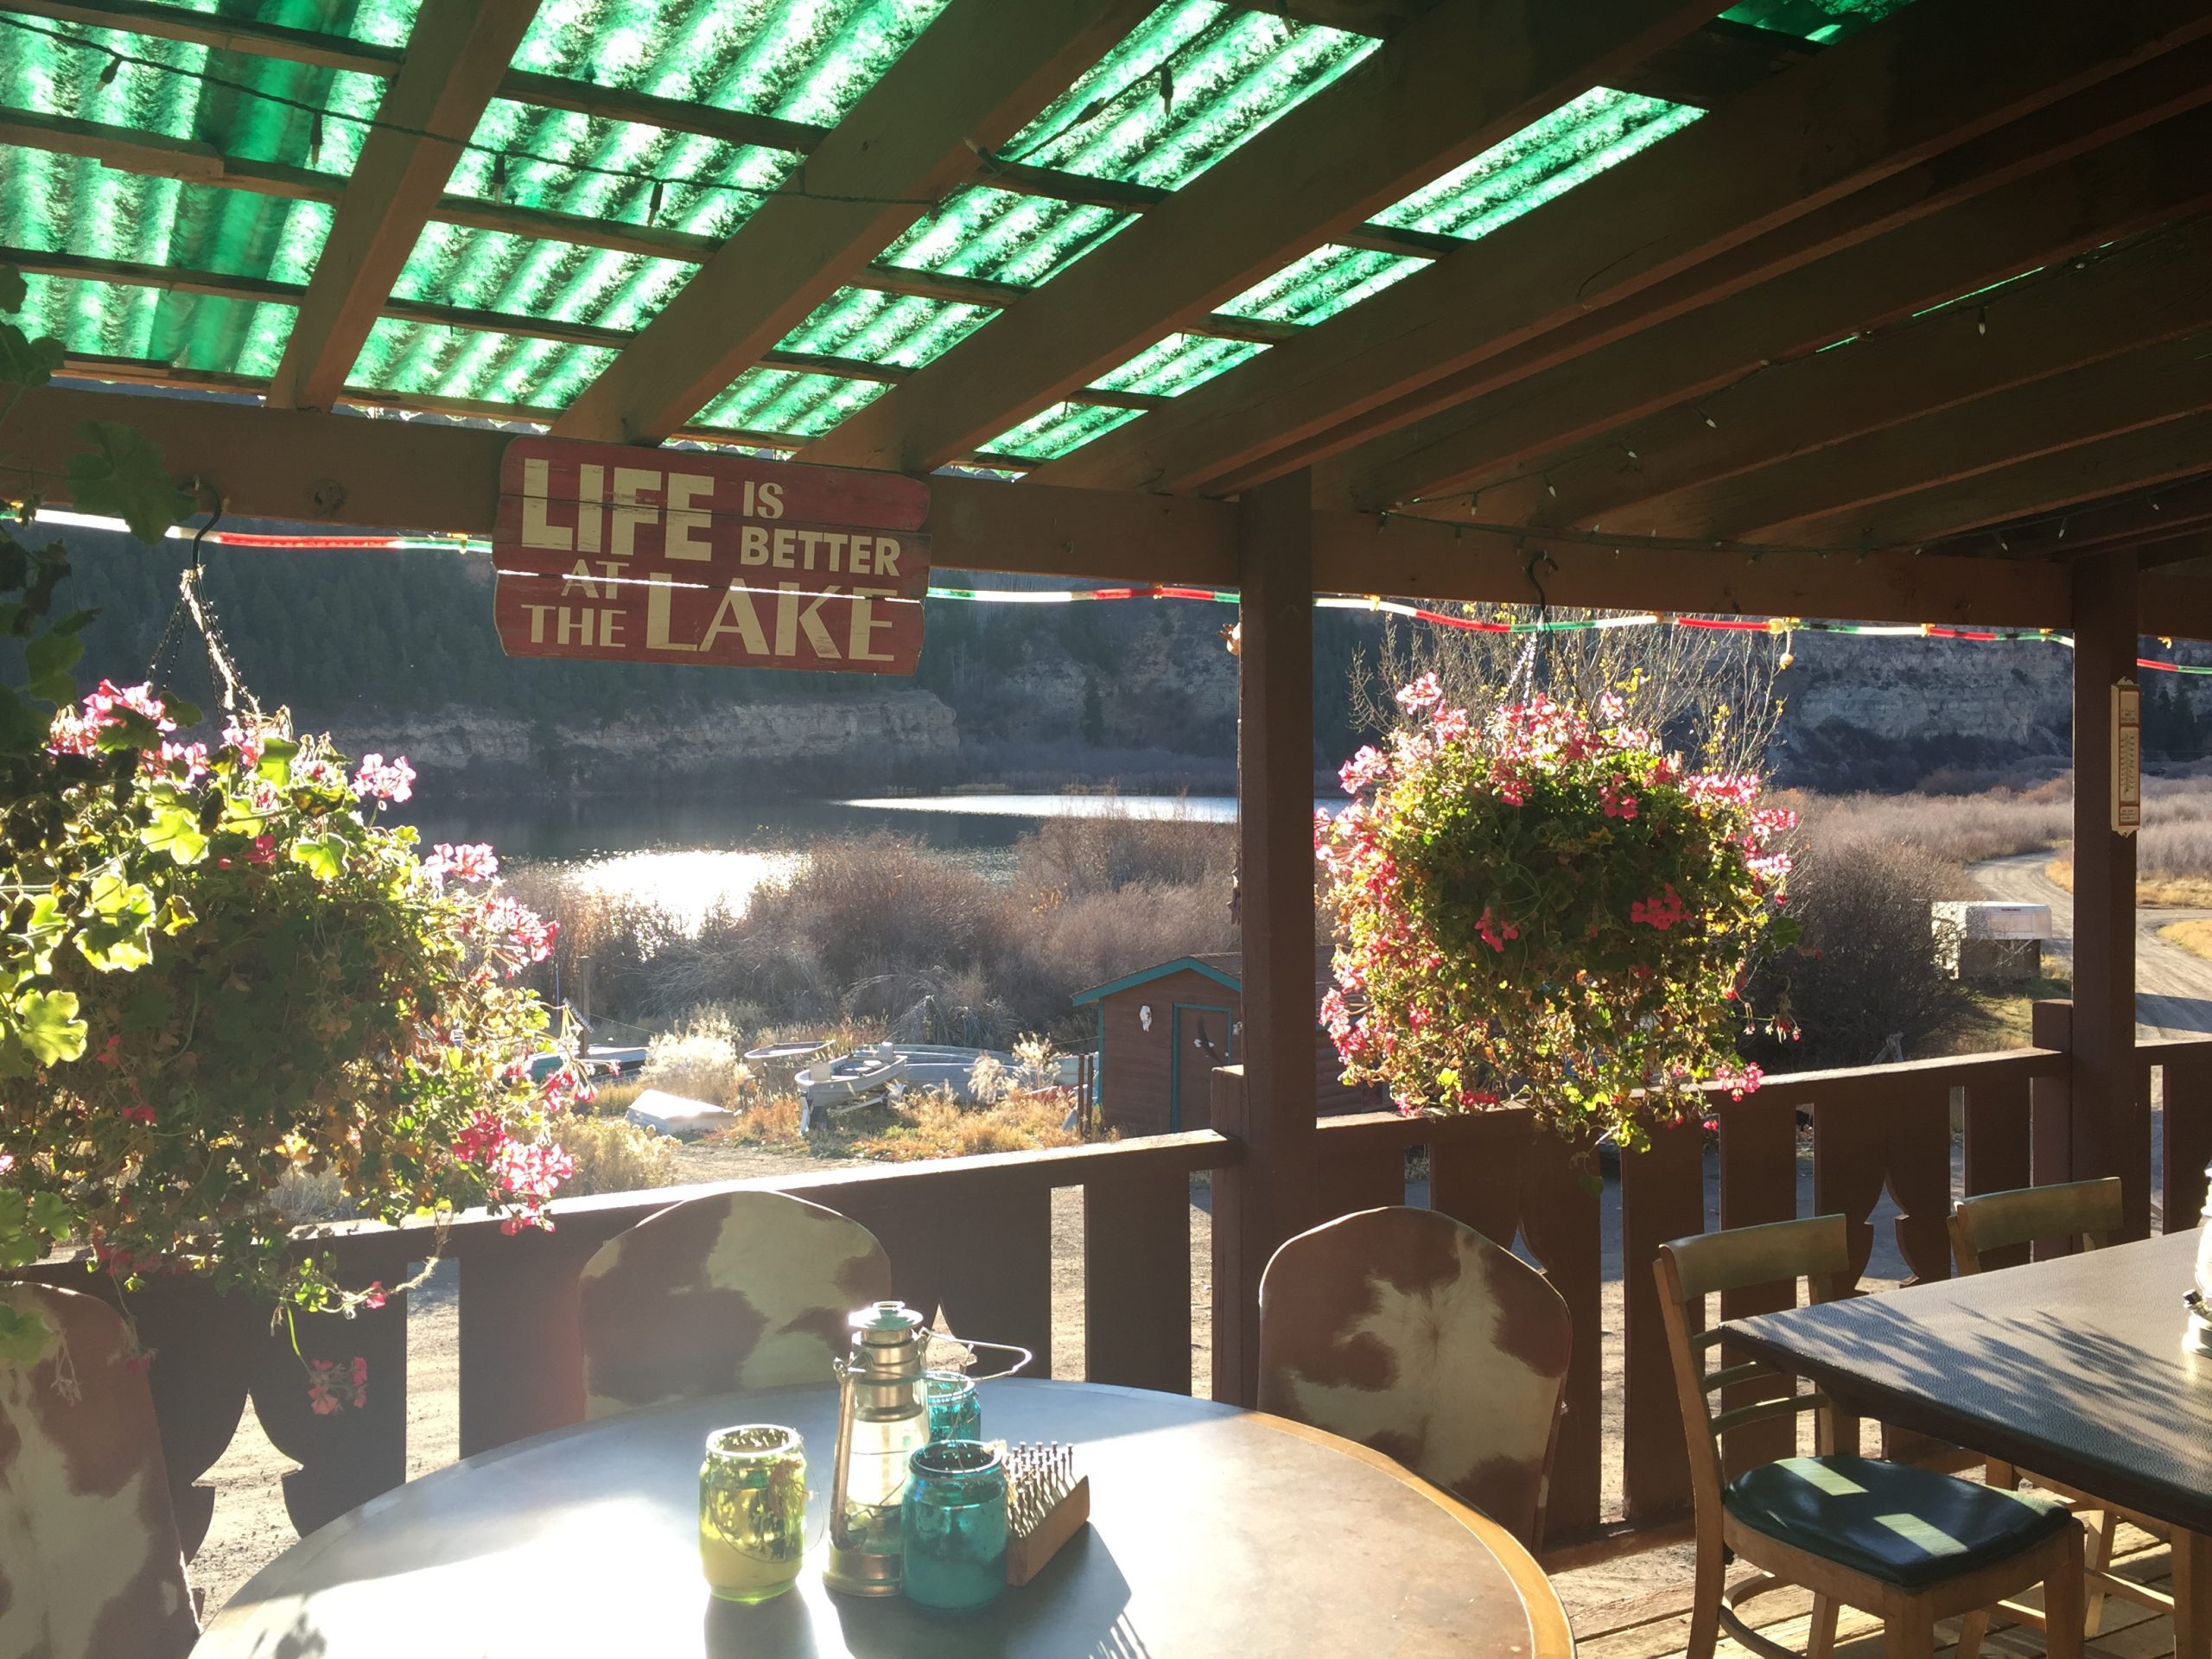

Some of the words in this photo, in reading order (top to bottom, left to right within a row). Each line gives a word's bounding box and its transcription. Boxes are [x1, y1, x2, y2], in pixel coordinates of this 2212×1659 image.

[523, 458, 715, 562] LIFE
[742, 480, 784, 519] IS
[741, 525, 901, 576] BETTER
[561, 559, 629, 599] AT
[521, 604, 627, 648] THE
[646, 572, 899, 661] LAKE
